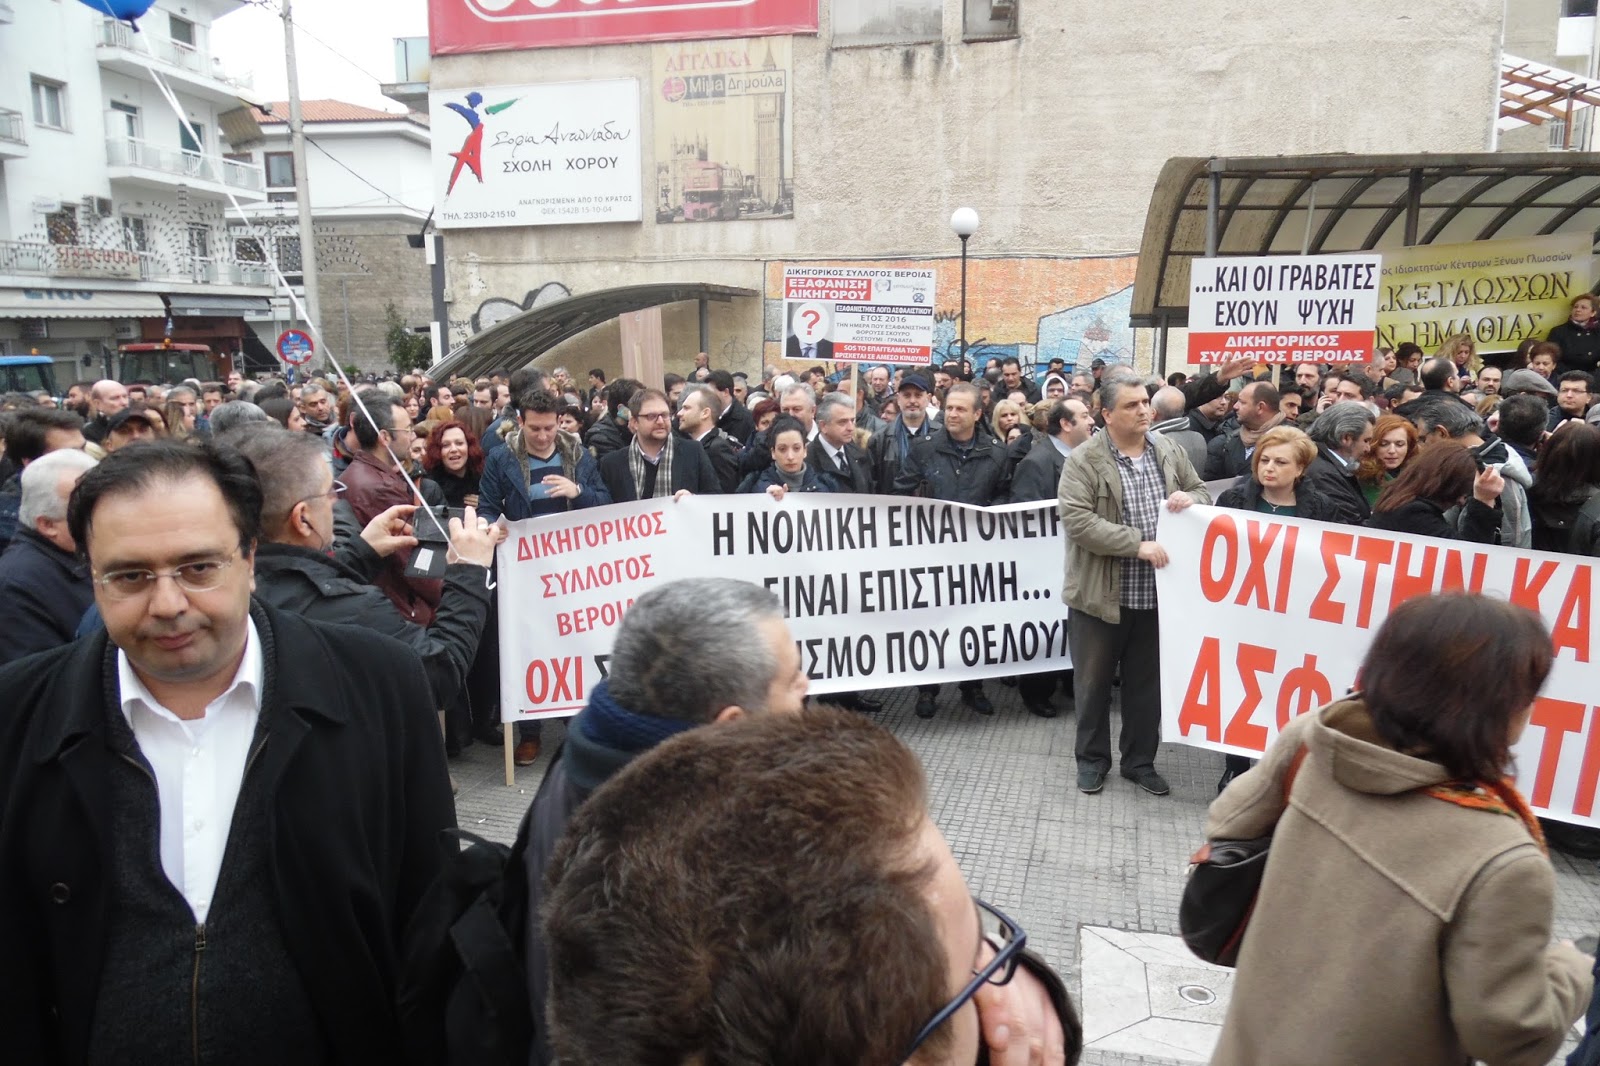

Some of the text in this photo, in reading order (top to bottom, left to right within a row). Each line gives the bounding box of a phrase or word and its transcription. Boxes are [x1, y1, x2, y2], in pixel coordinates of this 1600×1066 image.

[728, 75, 783, 92] Δημούλα
[503, 157, 618, 173] ΣΧΟΛΗ ΧΟΡΟΥ
[518, 197, 575, 206] ΑΝΑΓΝΩΡΙΣΜΕΝΗ
[577, 196, 592, 204] ΑΠΟ
[605, 195, 632, 203] ΚΡΑΤΟΣ
[443, 210, 516, 220] ΤΗΛ. 23310-21510
[1395, 264, 1448, 274] Ιδιοκτητών
[1451, 259, 1492, 270] Κέντρων
[1494, 255, 1524, 266] Ξένων
[1527, 252, 1572, 264] Γλωσσών
[789, 279, 868, 289] ΕΞΑΦΑΝΙΣΗ
[1195, 263, 1376, 293] ...ΚΑΙ ΟΙ ΓΡΑΒΑΤΕΣ
[788, 289, 868, 300] ΔΙΚΗΓΟΡΟΥ
[1377, 271, 1573, 313] .Κ.Ξ.ΓΛΩΣΣΩΝ
[836, 305, 876, 313] ΕΞΑΦΑΝΙΣΤΗΚΕ
[1215, 299, 1354, 326] ΕΧΟΥΝ ΨΥΧΗ
[885, 315, 907, 323] 2016
[868, 346, 905, 354] ΕΠΑΓΓΕΛΜΑ
[1225, 335, 1339, 347] ΔΙΚΗΓΟΡΙΚΟΣ
[1292, 350, 1364, 361] ΒΕΡΟΙΑΣ
[517, 511, 667, 562] ΔΙΚΗΓΟΡΙΚΟΣ
[713, 512, 734, 556] Η
[748, 507, 877, 555] ΝΟΜΙΚΗ
[888, 505, 968, 547] ΕΙΝΑΙ
[1200, 514, 1299, 614] ΟΧΙ
[540, 554, 655, 598] ΣΥΛΛΟΓΟΣ
[860, 561, 1051, 613] ΕΠΙΣΤΗΜΗ...
[886, 628, 950, 674] ΠΟΥ
[525, 656, 584, 704] ΟΧΙ
